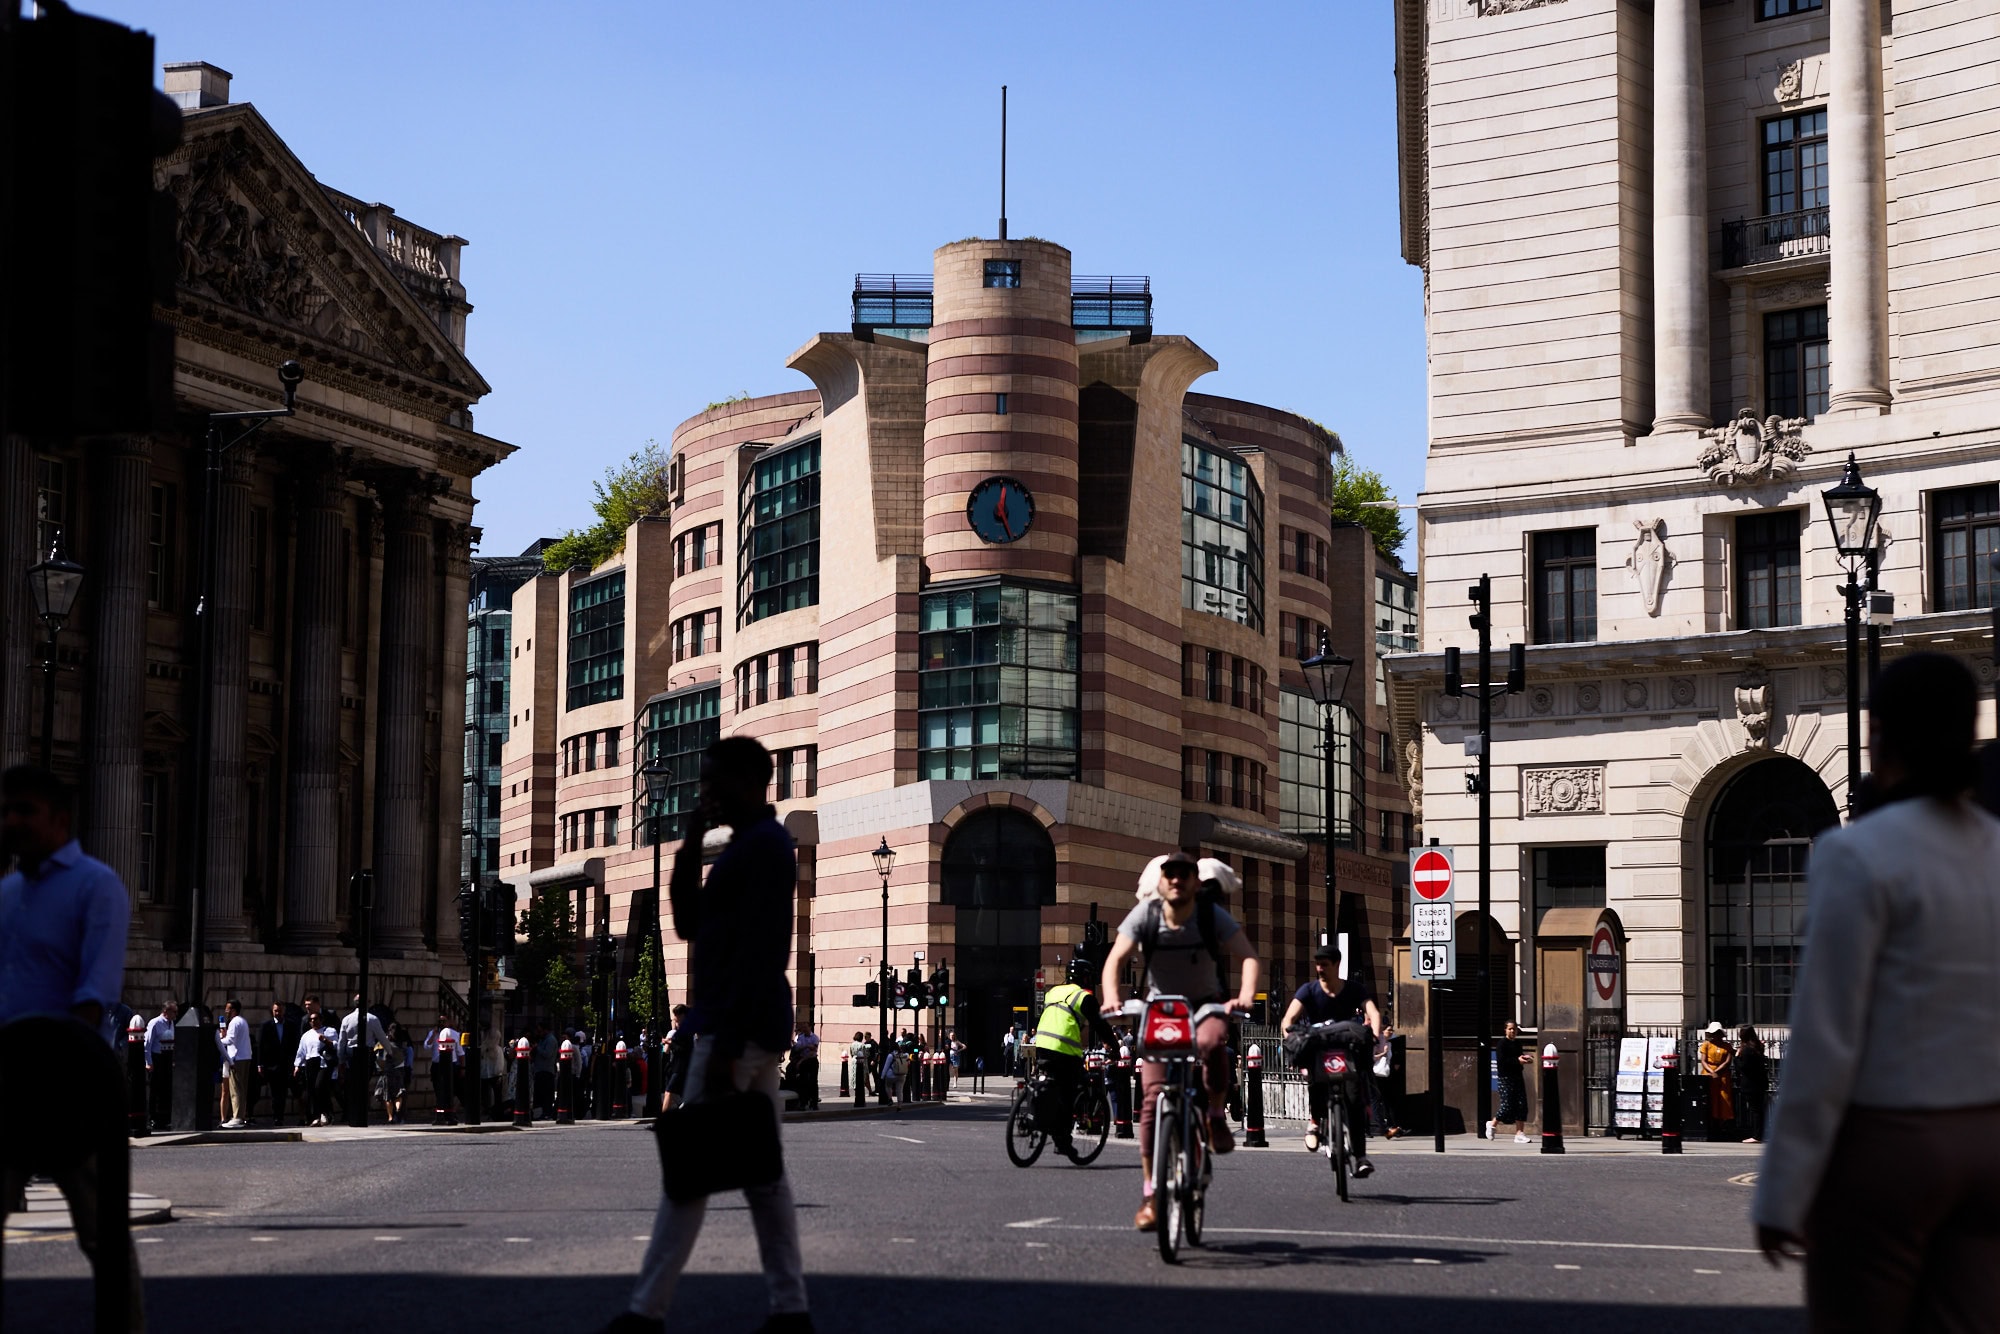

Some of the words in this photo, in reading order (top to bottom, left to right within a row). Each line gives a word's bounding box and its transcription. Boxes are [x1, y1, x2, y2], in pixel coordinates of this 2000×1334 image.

[1419, 908, 1446, 917] Except
[1442, 918, 1448, 926] &
[1420, 929, 1445, 938] cycles
[1590, 958, 1618, 970] UNDERGROUND
